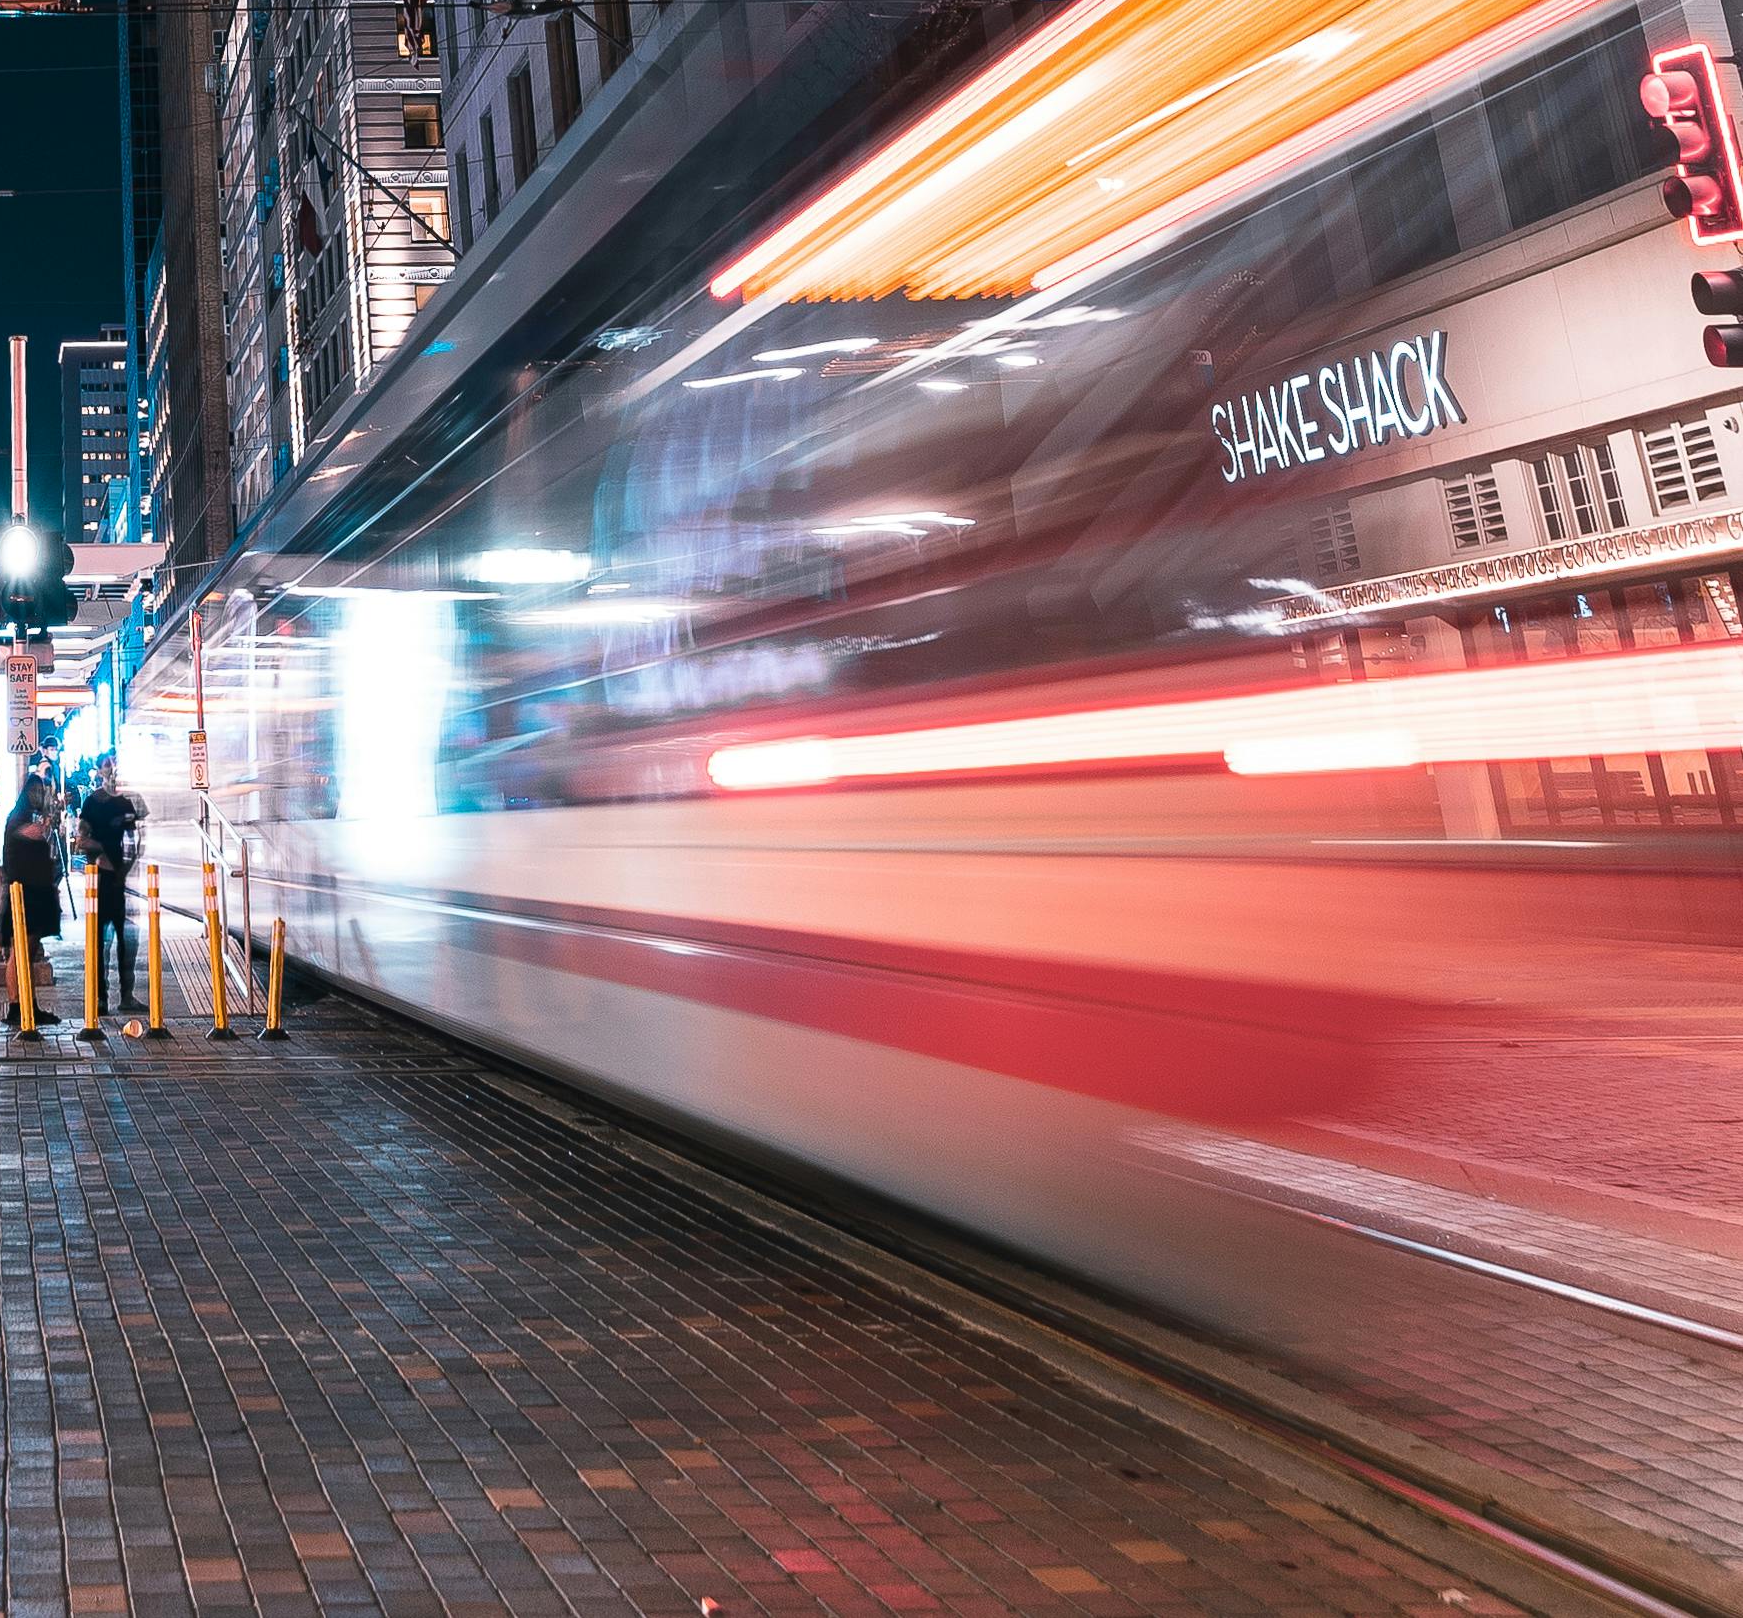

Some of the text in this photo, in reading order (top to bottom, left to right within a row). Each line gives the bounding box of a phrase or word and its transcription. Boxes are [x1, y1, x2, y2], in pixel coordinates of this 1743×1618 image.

[1211, 330, 1461, 483] SHAKE SHACK
[1431, 563, 1478, 594] SHAKES
[1561, 529, 1651, 570] CONCRETES
[1657, 517, 1717, 552] FLOATS
[10, 663, 33, 672] STAY
[10, 674, 33, 683] SAFE
